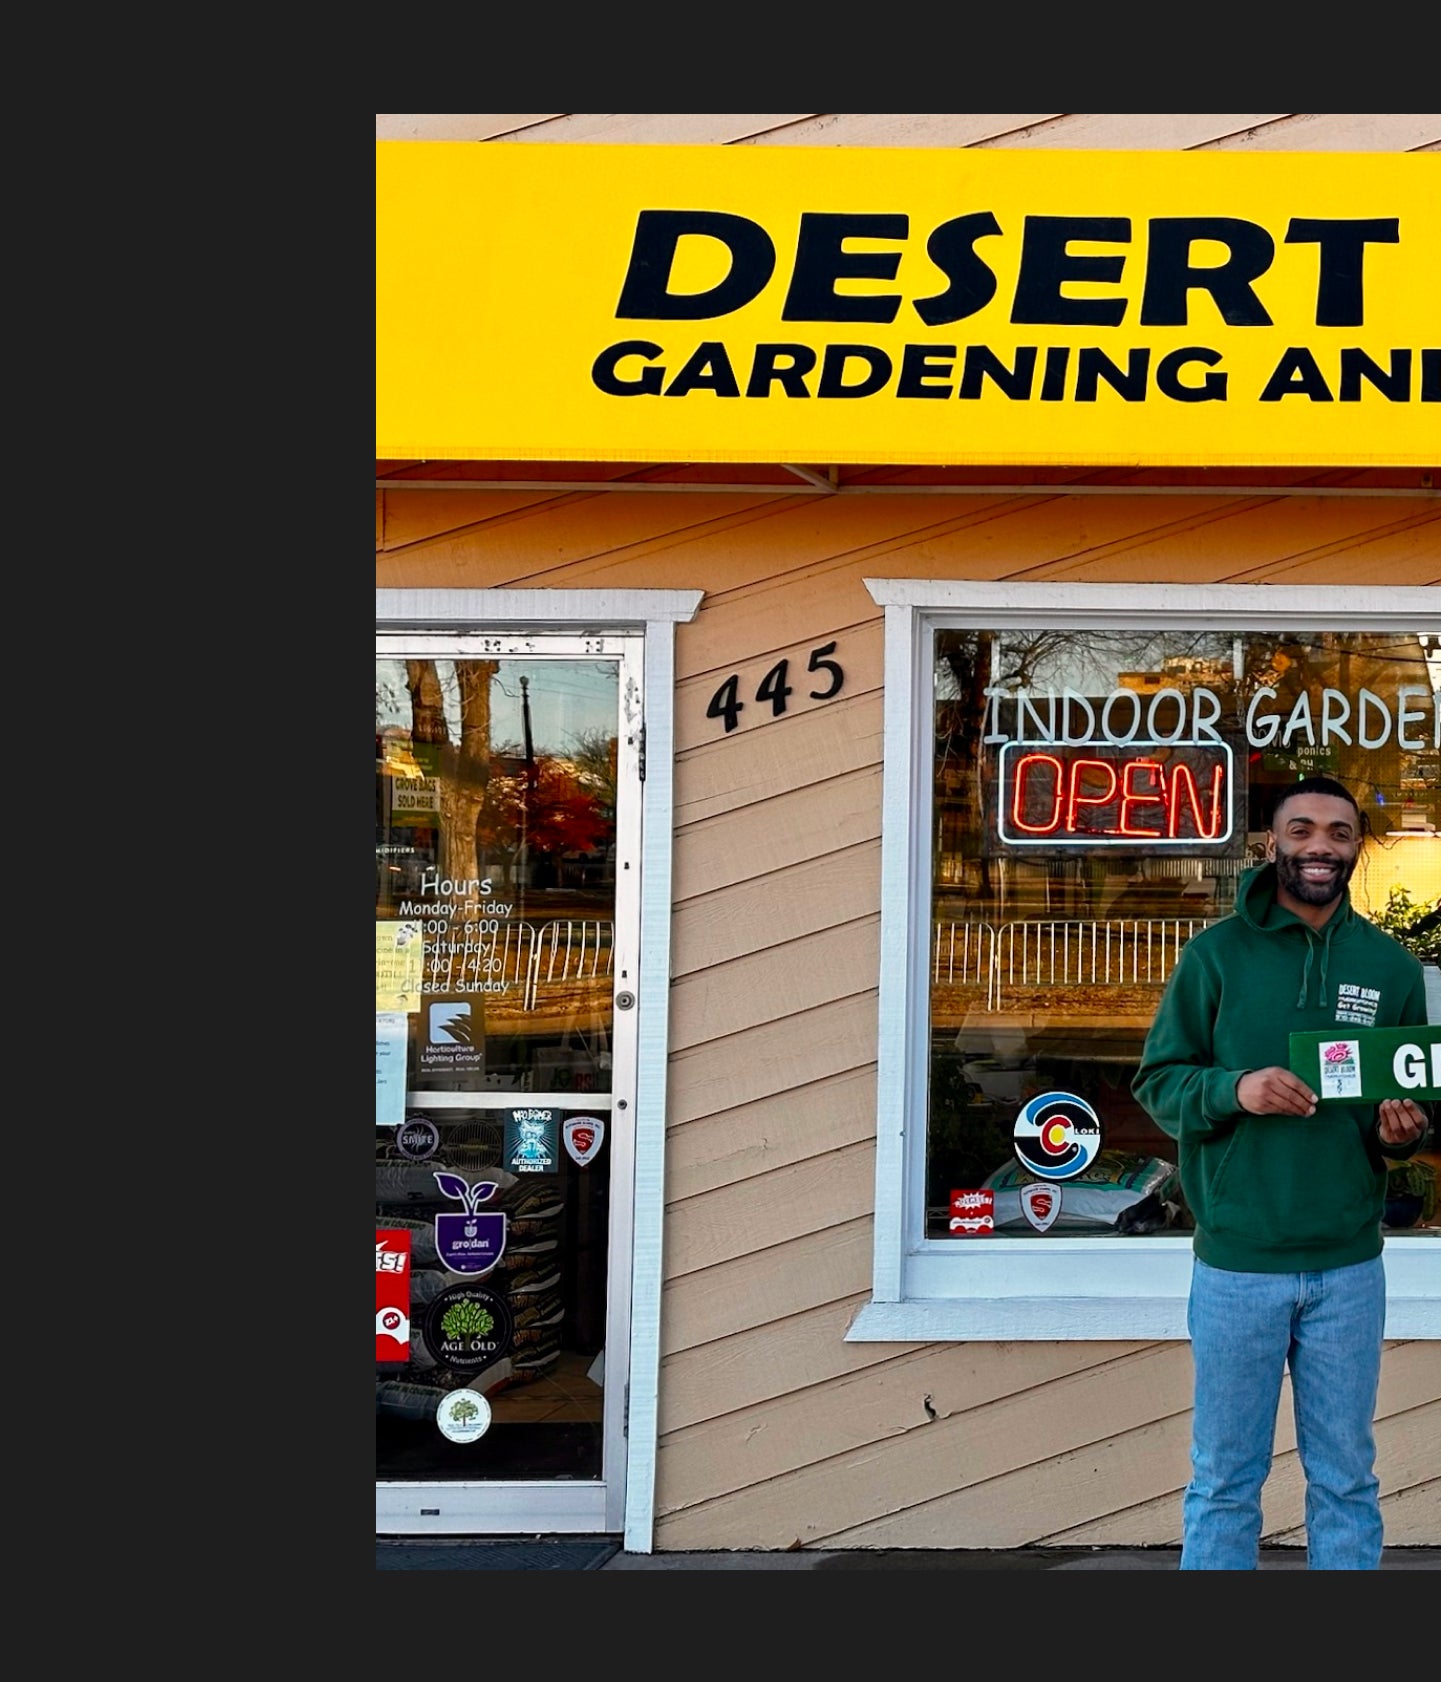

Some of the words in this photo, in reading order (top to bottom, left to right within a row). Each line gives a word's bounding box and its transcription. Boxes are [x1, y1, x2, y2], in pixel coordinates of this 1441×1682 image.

[615, 208, 1400, 328] DESERT
[591, 340, 1229, 403] GARDENING
[706, 640, 844, 733] 445
[983, 687, 1223, 748] INDOOR
[1011, 753, 1223, 840] OPEN
[420, 872, 493, 896] Hours
[399, 900, 514, 919] Monday-Friday
[464, 919, 499, 934] 6:00
[422, 939, 492, 957] Saturday
[467, 958, 502, 973] 4:20
[401, 979, 450, 993] Closed
[455, 979, 510, 996] Sunday
[1338, 983, 1360, 998] DESERT
[1361, 987, 1380, 1001] BLOOM
[425, 1045, 475, 1054] Horticulture
[420, 1054, 454, 1064] Lighting
[455, 1053, 481, 1062] Group
[511, 1157, 552, 1165] AUTHORIZED
[518, 1164, 544, 1172] DEALER
[448, 1292, 465, 1301] High
[465, 1290, 491, 1301] Quality
[440, 1341, 464, 1351] AGE
[470, 1340, 497, 1351] OLD
